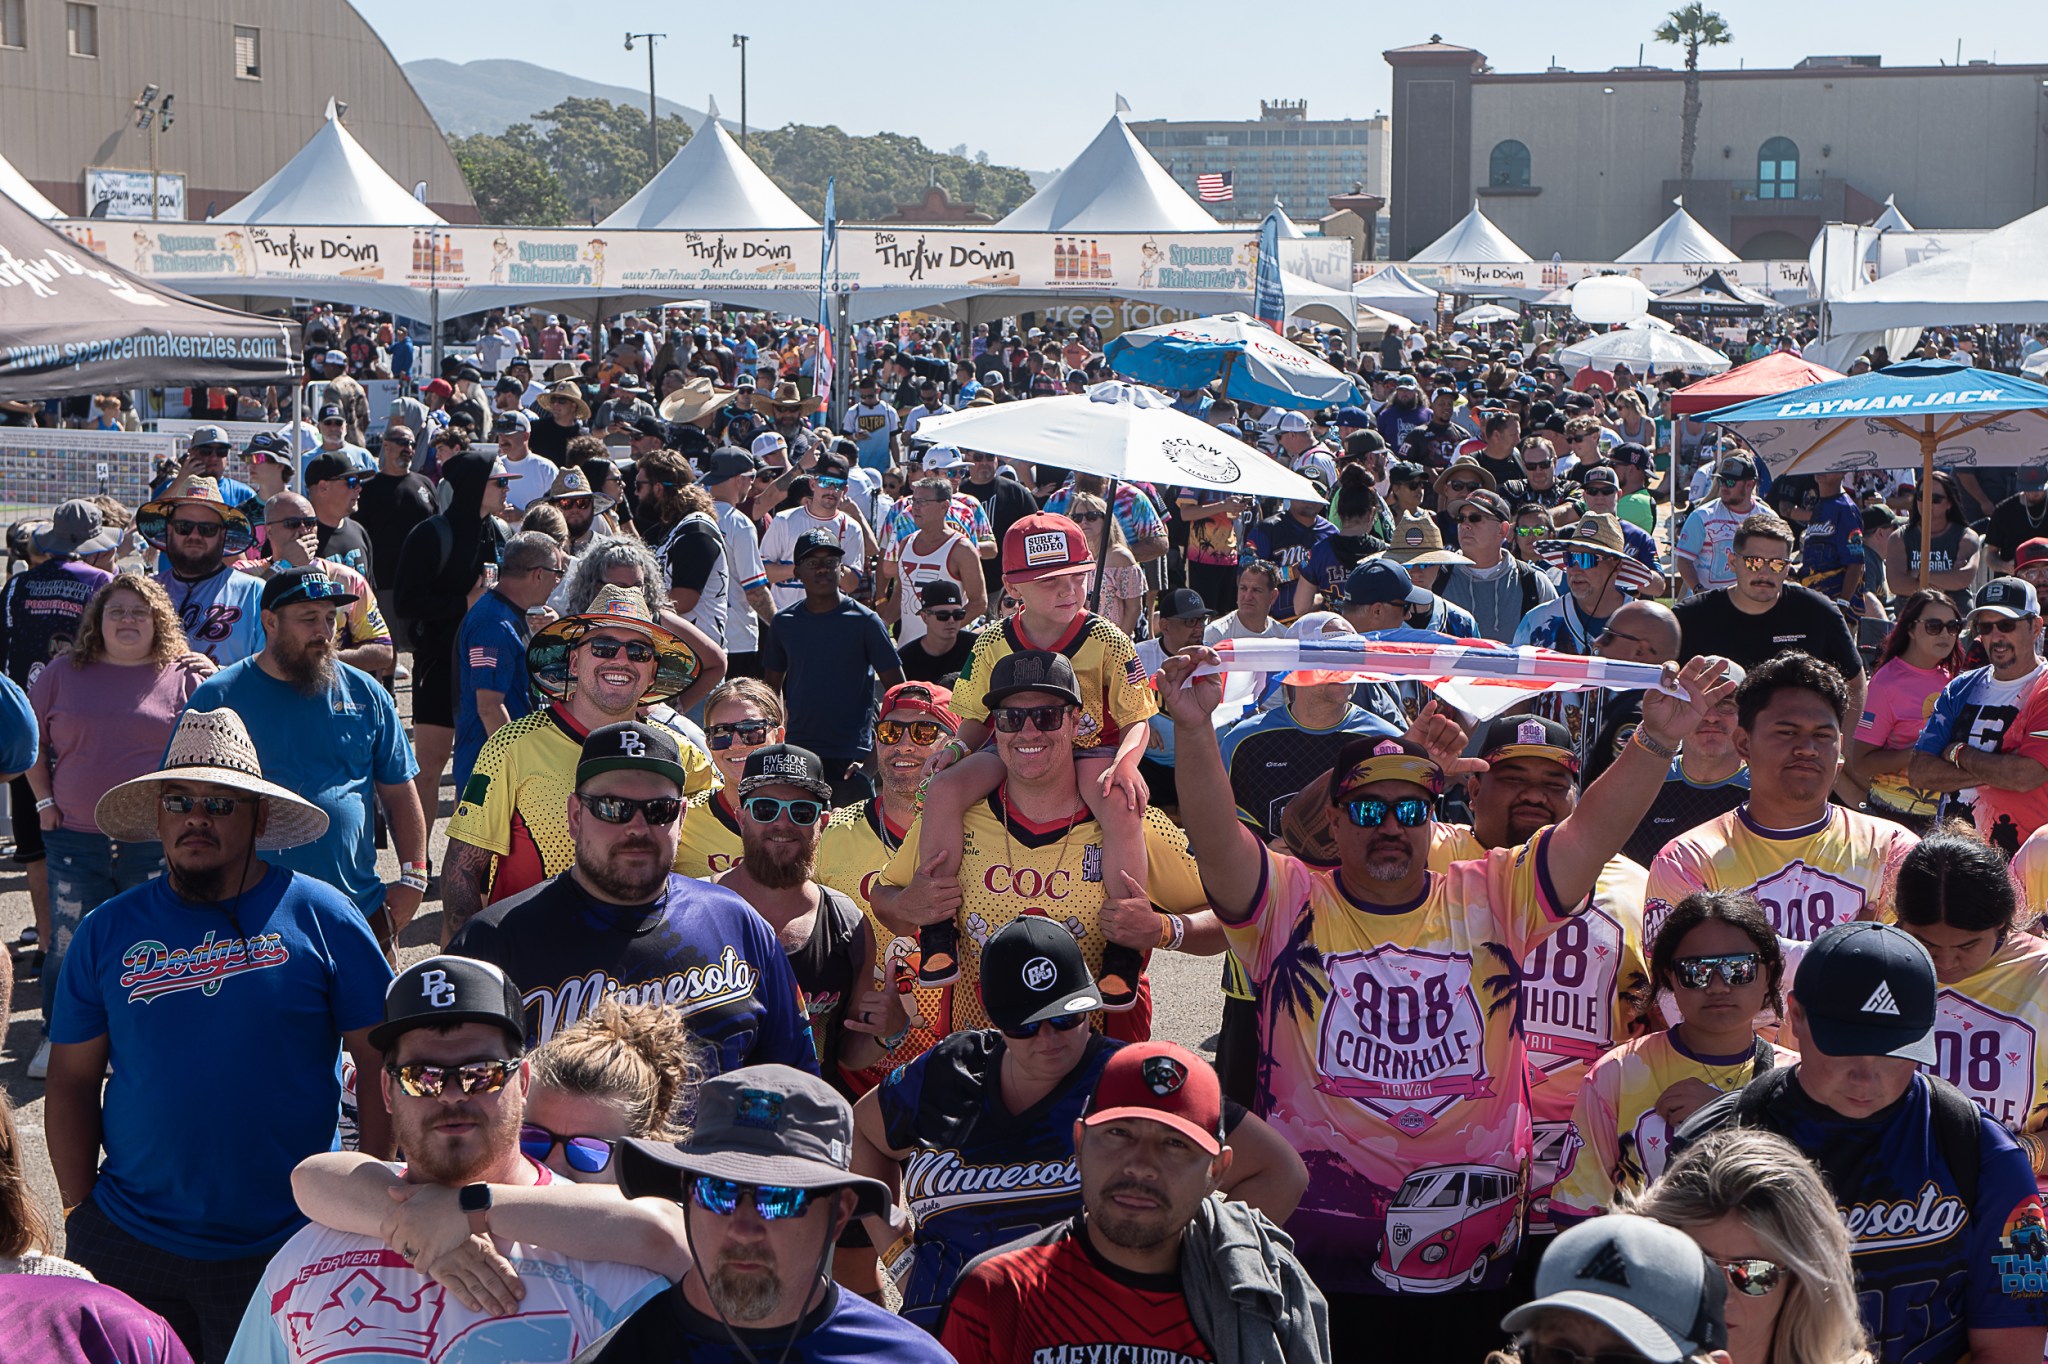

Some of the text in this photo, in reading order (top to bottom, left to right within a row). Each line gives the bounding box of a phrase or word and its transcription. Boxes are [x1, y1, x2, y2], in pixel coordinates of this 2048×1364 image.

[157, 233, 217, 254] Spencer
[320, 237, 380, 262] Down
[743, 239, 792, 260] Down
[875, 232, 896, 246] the
[518, 240, 579, 263] Spencer
[950, 242, 1015, 270] Down
[1168, 243, 1234, 267] Spencer
[508, 263, 593, 284] Makenzie's
[622, 268, 860, 282] www.TheThrowDownCornholeTournamnt.com
[1158, 267, 1248, 290] Makenzie's
[7, 330, 277, 371] www.spencermakenzies.com
[1777, 388, 2005, 417] CAYMAN JACK
[859, 416, 885, 431] ULTRA
[1175, 438, 1222, 455] CLAW
[1028, 542, 1064, 555] RODEO
[1029, 535, 1053, 547] SURF
[1911, 560, 1952, 572] HORIBLE
[1912, 550, 1941, 561] THT'S
[619, 730, 646, 757] BG
[763, 753, 808, 768] FIVE4ONE
[763, 763, 808, 777] BAGGERS
[983, 864, 1071, 900] COC
[1522, 917, 1589, 988] 08
[120, 931, 289, 998] Dodgers
[421, 969, 456, 1007] BG
[1353, 971, 1454, 1046] 808
[1336, 1028, 1472, 1081] CORNHOLE
[1915, 1030, 2001, 1091] 08
[1381, 1082, 1433, 1097] HAWAII
[905, 1150, 1081, 1198] Minnesot
